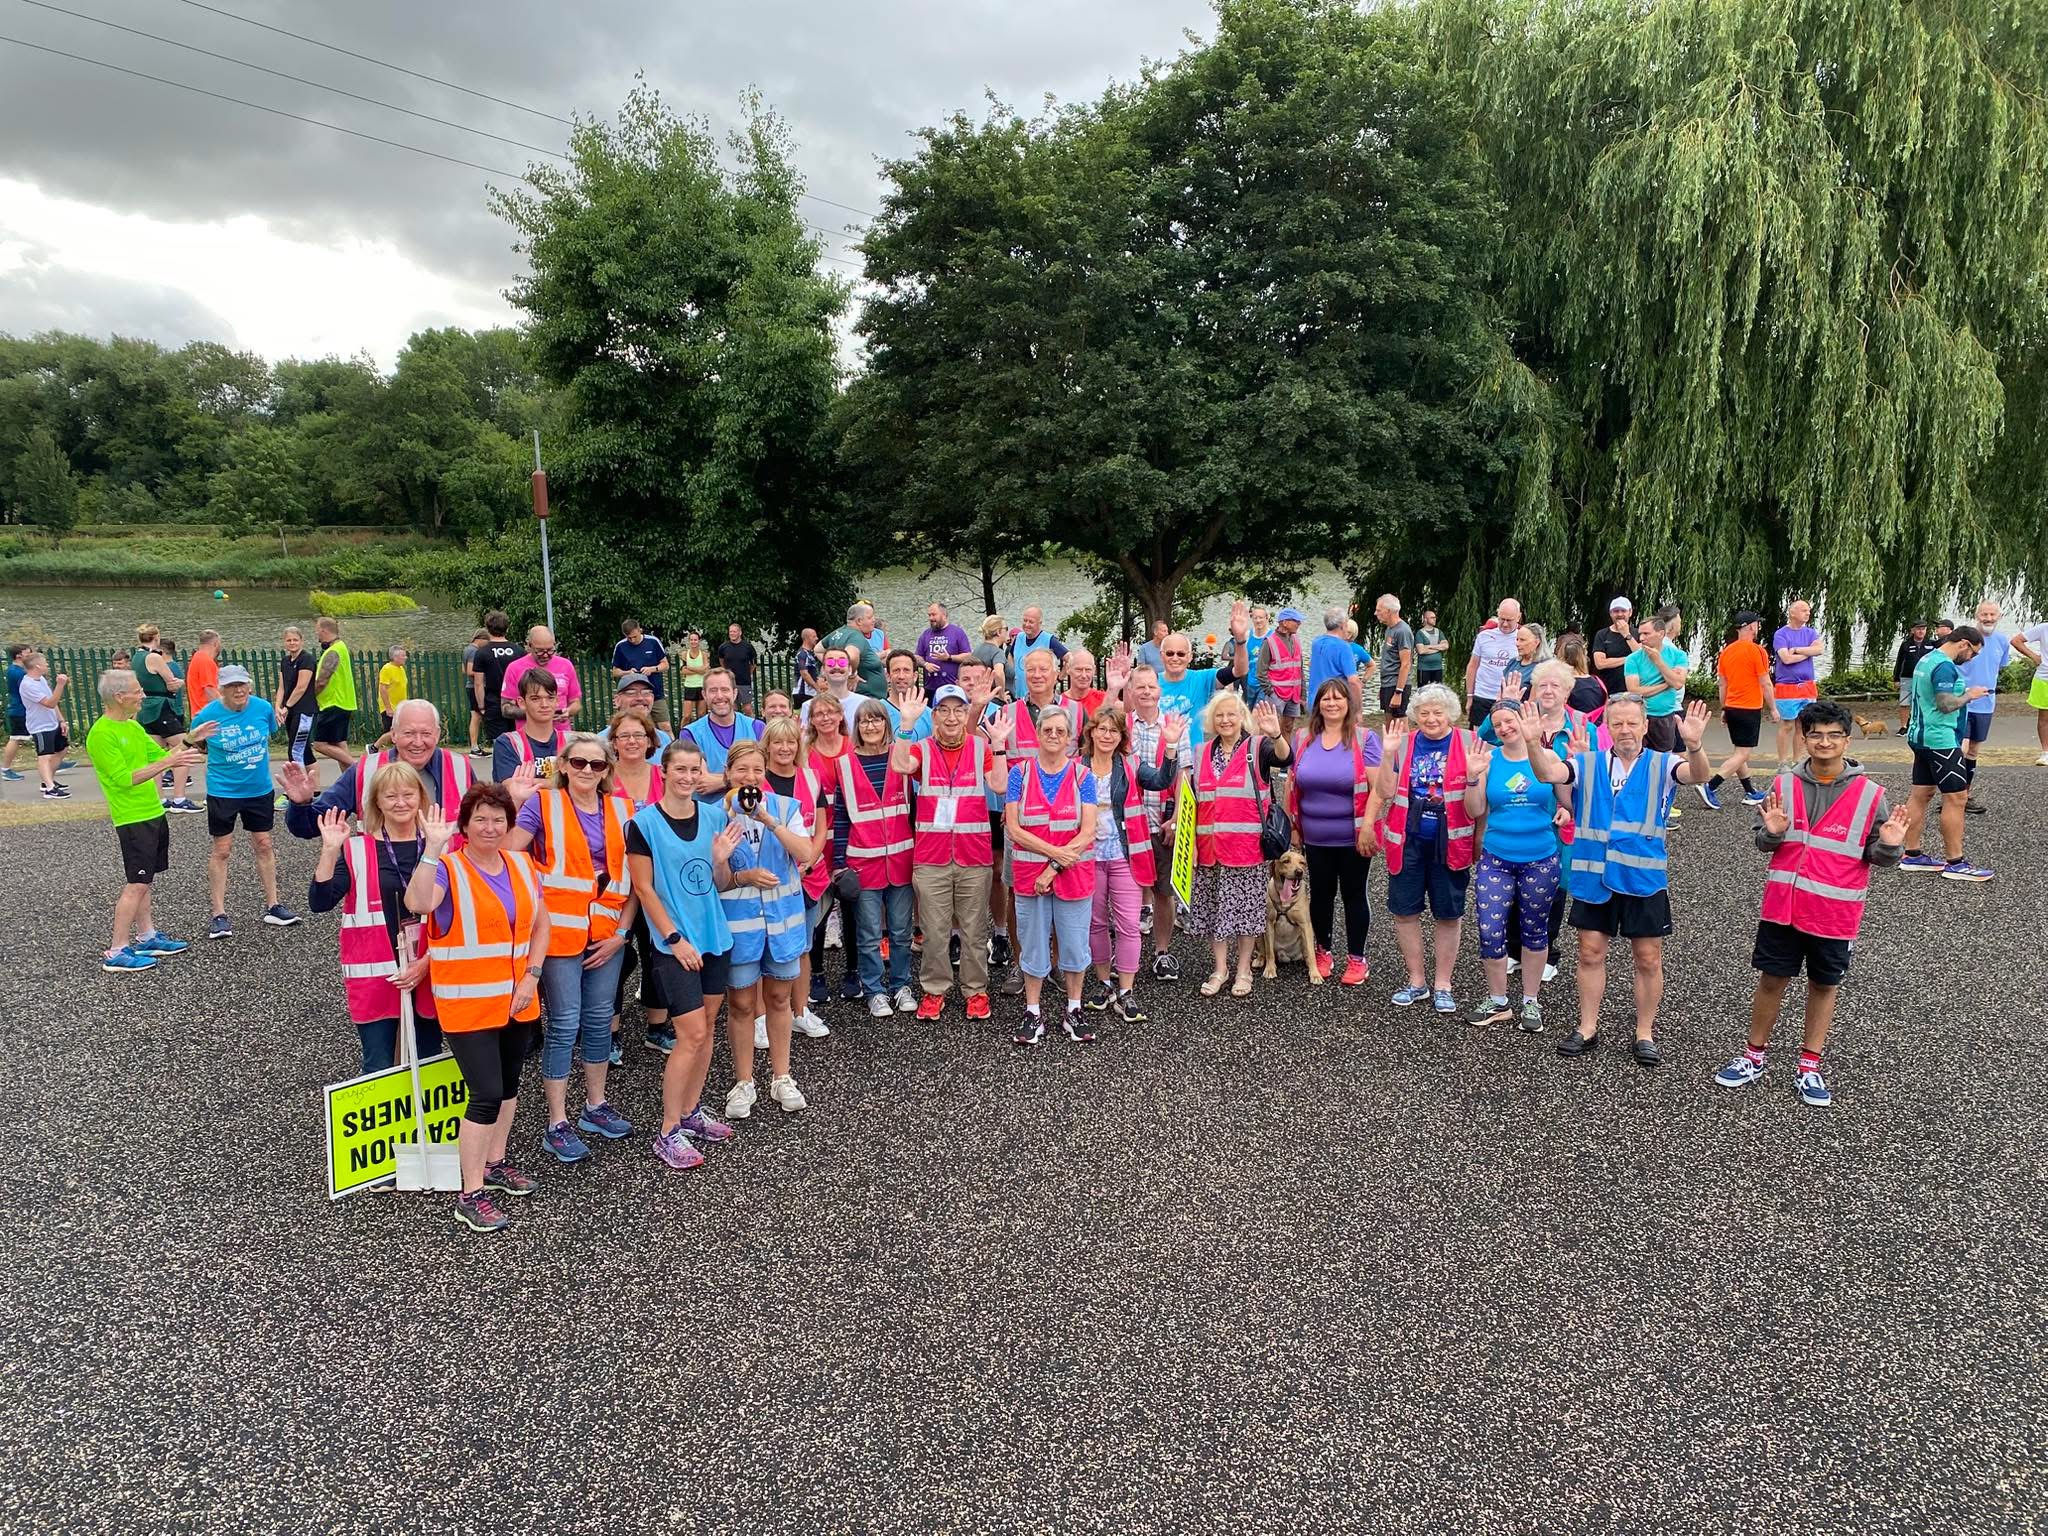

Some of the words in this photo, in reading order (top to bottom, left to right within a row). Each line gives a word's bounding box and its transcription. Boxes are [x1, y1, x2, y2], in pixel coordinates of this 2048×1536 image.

[491, 647, 514, 659] 100
[929, 644, 948, 654] 10K
[222, 739, 237, 752] RUN
[1175, 794, 1189, 879] CAUTION
[1181, 800, 1194, 892] RUNNERS
[350, 1115, 461, 1173] CAION
